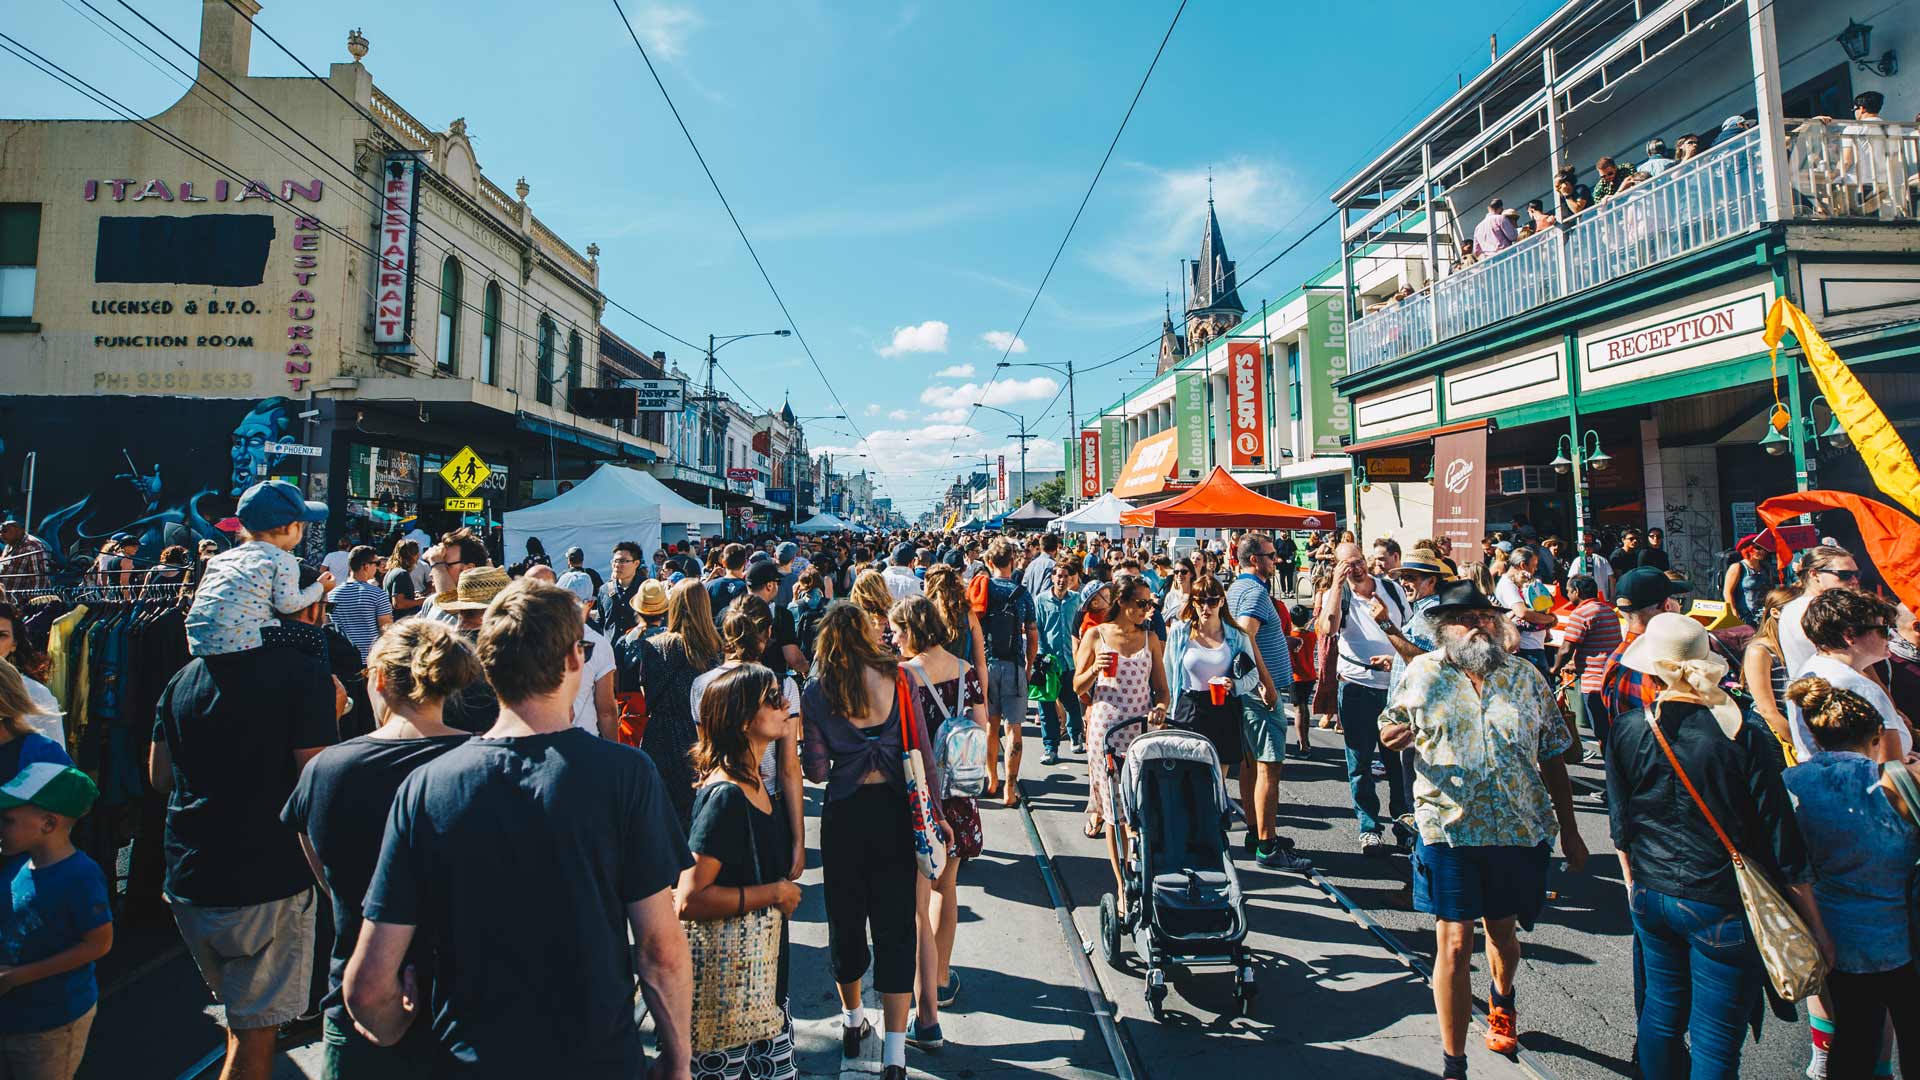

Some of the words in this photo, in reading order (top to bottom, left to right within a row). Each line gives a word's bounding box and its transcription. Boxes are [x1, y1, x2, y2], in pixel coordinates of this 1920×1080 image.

[83, 178, 323, 202] ITALIAN
[379, 180, 411, 336] RESTAURANT
[91, 300, 173, 315] LICENSED
[184, 300, 198, 315] &
[207, 300, 261, 315] B.Y.O.
[285, 216, 320, 392] RESTAURANT
[1324, 299, 1345, 348] here
[94, 335, 188, 348] FUNCTION
[197, 335, 254, 348] ROOM
[1607, 308, 1735, 362] RECEPTION
[1186, 376, 1201, 412] here
[1235, 353, 1257, 430] savers
[1326, 355, 1350, 431] donte
[283, 444, 314, 455] PHOENIX
[1109, 421, 1120, 445] here
[1187, 414, 1203, 466] donate
[1085, 436, 1096, 479] savers
[453, 499, 466, 509] 75
